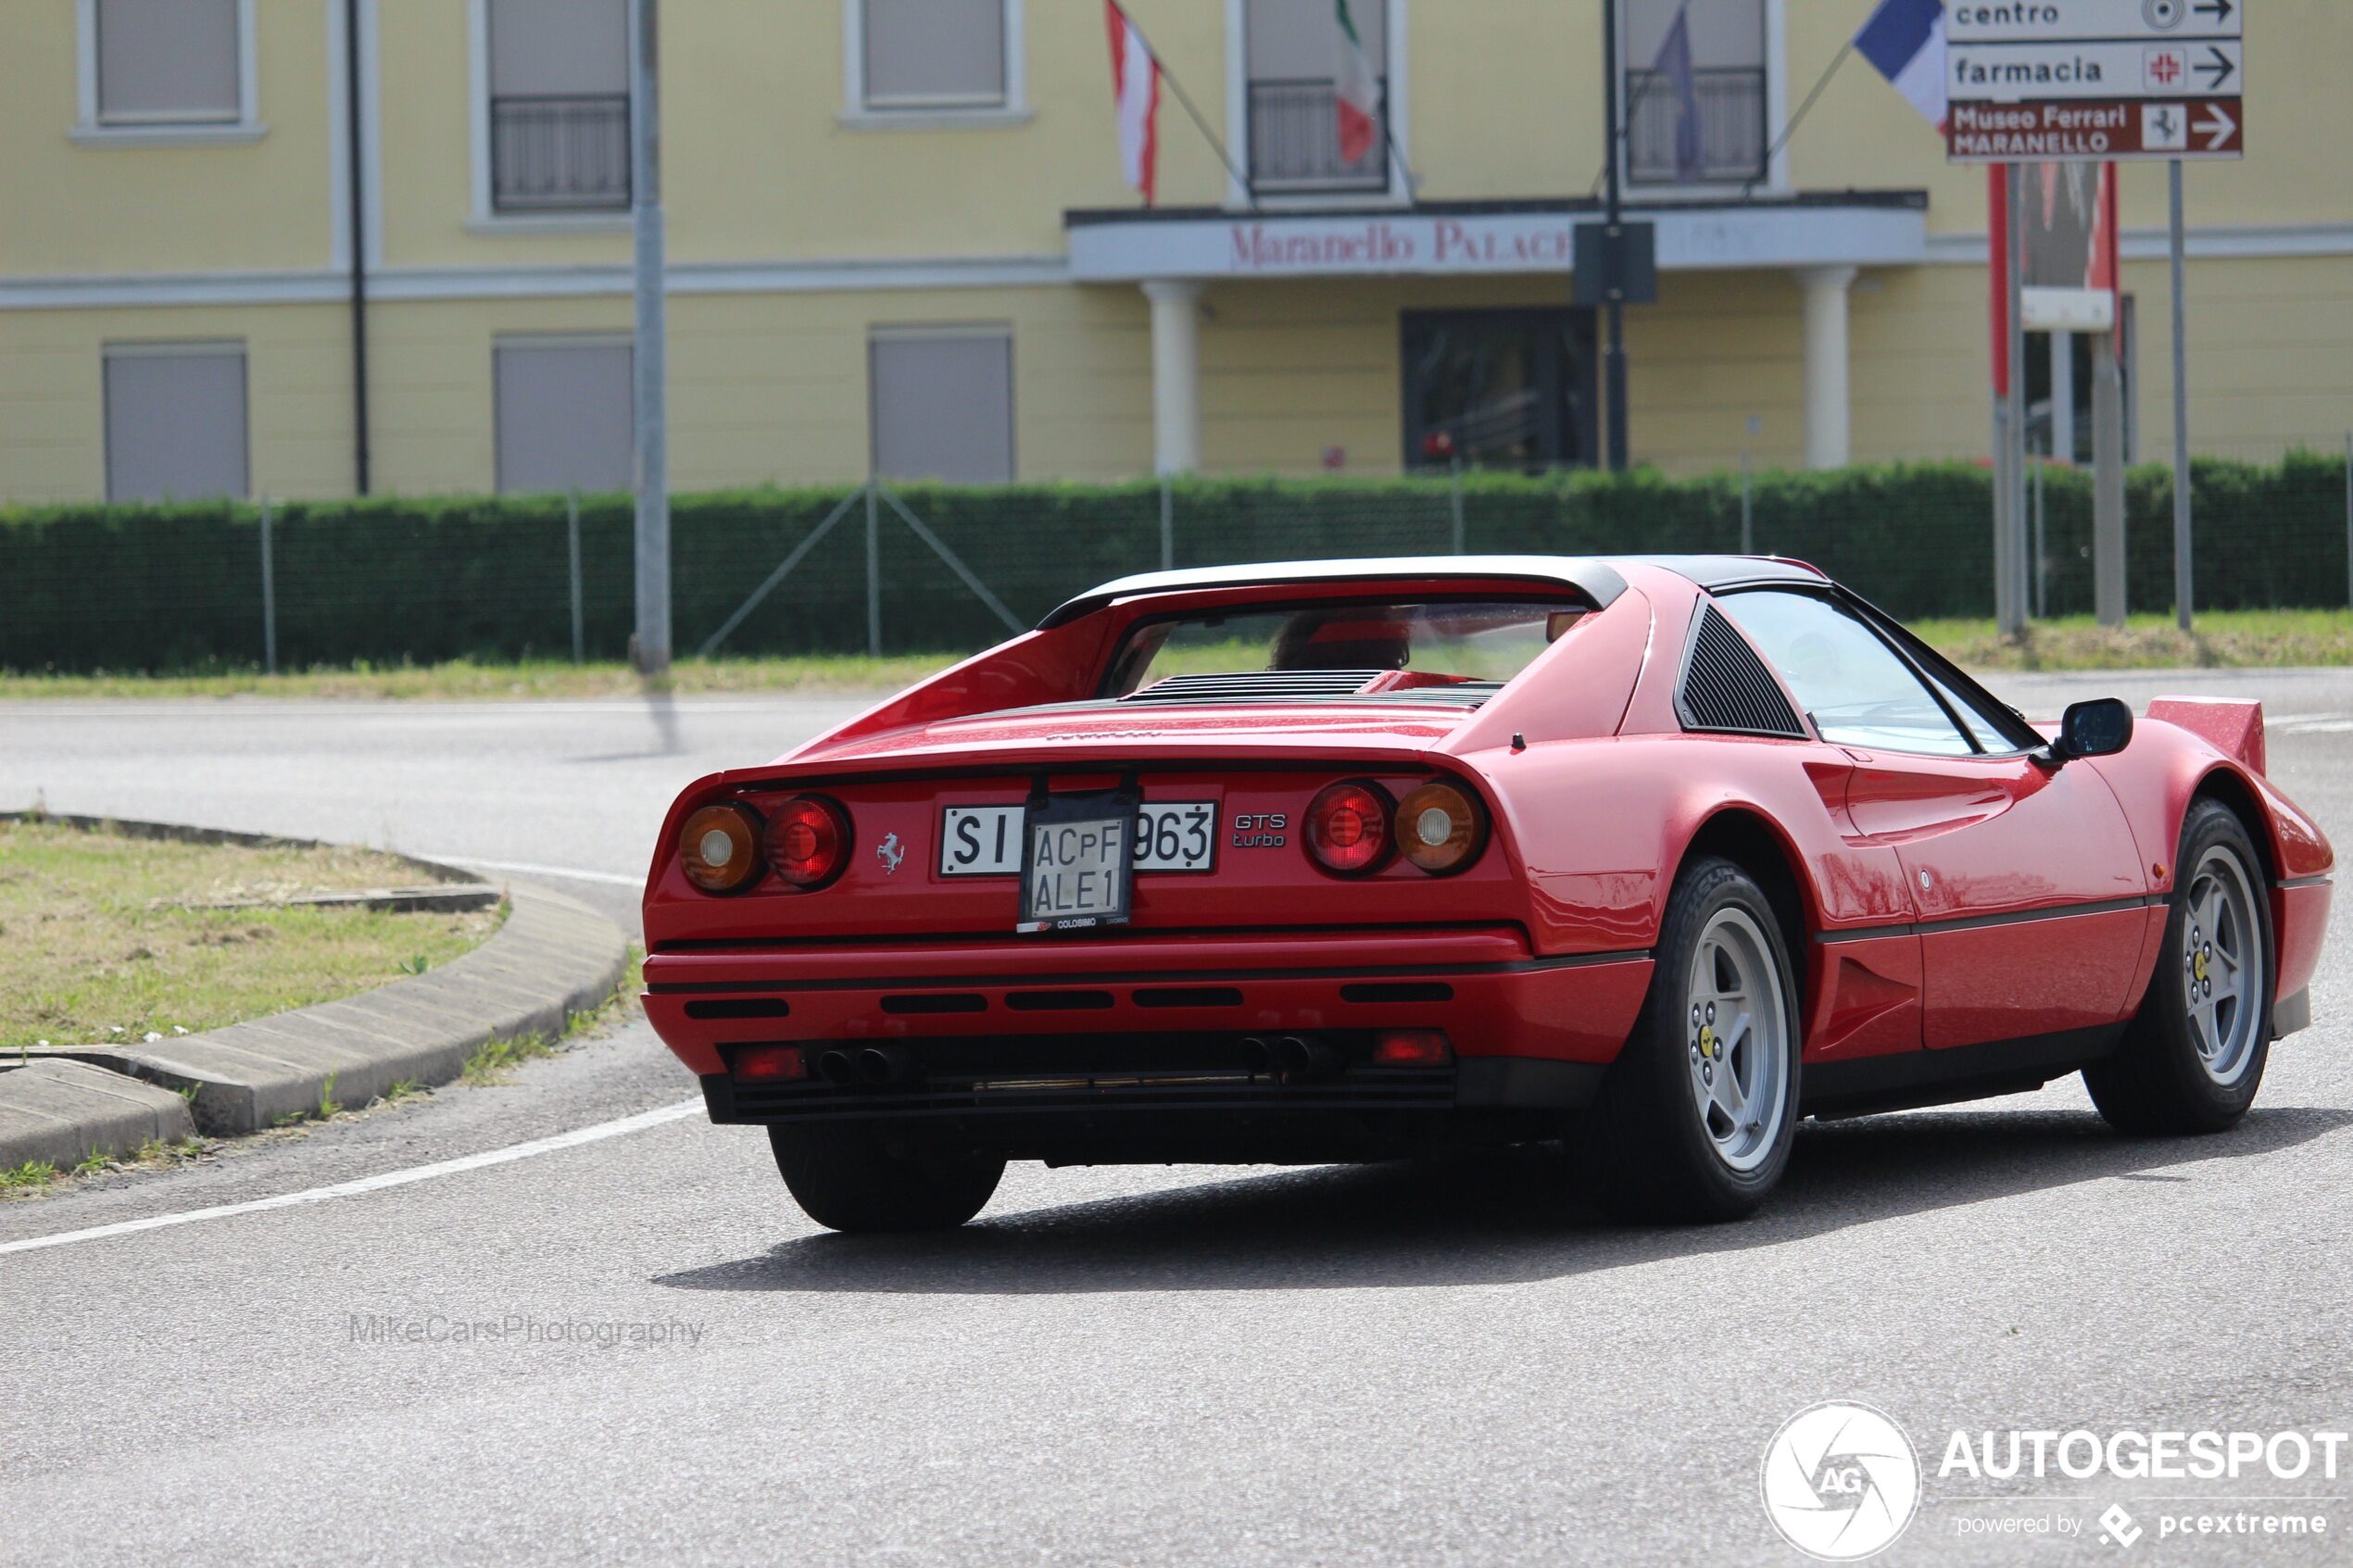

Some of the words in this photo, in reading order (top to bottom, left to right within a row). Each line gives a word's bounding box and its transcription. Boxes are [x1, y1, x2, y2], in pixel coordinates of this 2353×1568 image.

[1956, 2, 2058, 25] centro
[1956, 56, 2102, 83] farmacia
[1954, 107, 2036, 131] Museo
[2043, 104, 2126, 129] Ferrari
[1954, 132, 2108, 155] MARANELLO
[1230, 220, 1416, 267] Maranello
[1235, 814, 1288, 830] GTS
[953, 814, 1007, 864] SI
[1233, 833, 1286, 847] turbo
[1035, 871, 1113, 912] ALE1
[1057, 918, 1097, 929] COLOSIMO
